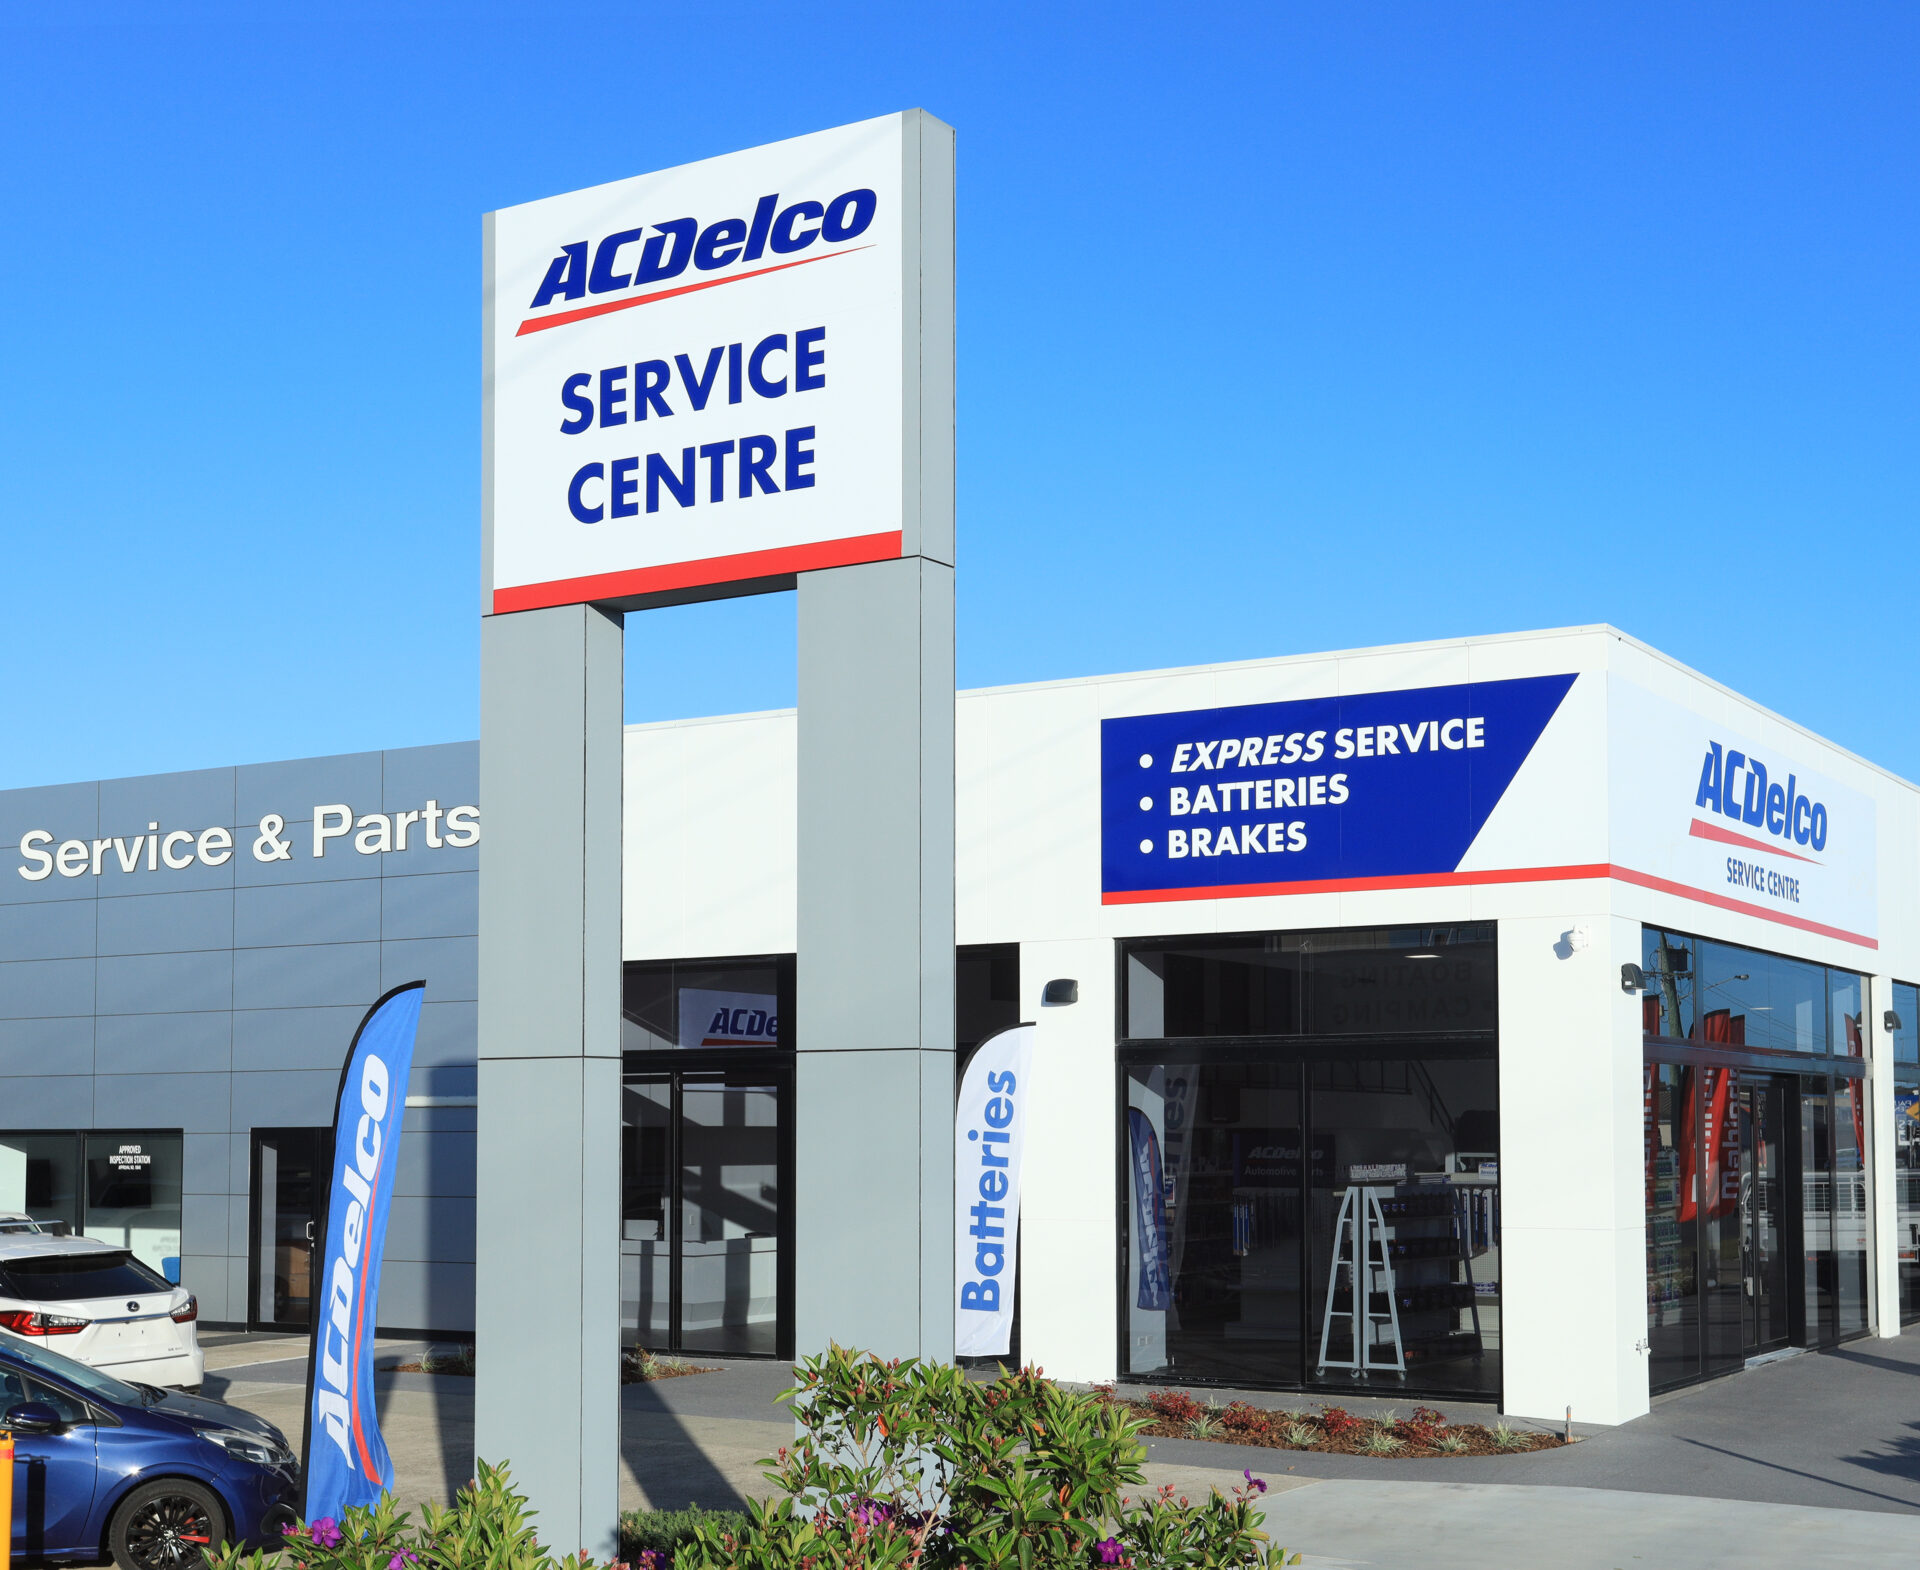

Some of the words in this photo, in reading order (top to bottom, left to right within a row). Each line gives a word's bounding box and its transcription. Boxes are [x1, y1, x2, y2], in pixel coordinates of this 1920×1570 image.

[529, 188, 877, 309] ACDelco
[560, 325, 826, 436] SERVICE
[567, 424, 816, 524] CENTRE
[1170, 731, 1327, 773] EXPRESS
[1333, 716, 1486, 760] SERVICE
[1169, 773, 1350, 816] BATTERIES
[1695, 739, 1828, 853] ACDelco
[17, 820, 234, 882] Service
[252, 813, 292, 863] &
[313, 799, 480, 858] Parts
[1168, 821, 1308, 860] BRAKES
[1726, 857, 1765, 892] SERVICE
[1767, 871, 1800, 903] CENTRE
[708, 1007, 777, 1037] ACDe
[109, 1155, 133, 1165] INSPECTION
[133, 1155, 151, 1165] STATION
[119, 1145, 141, 1154] APPROVED
[1247, 1146, 1324, 1160] ACDelo
[960, 1070, 1017, 1312] Batteries
[318, 1054, 389, 1471] ACDelco
